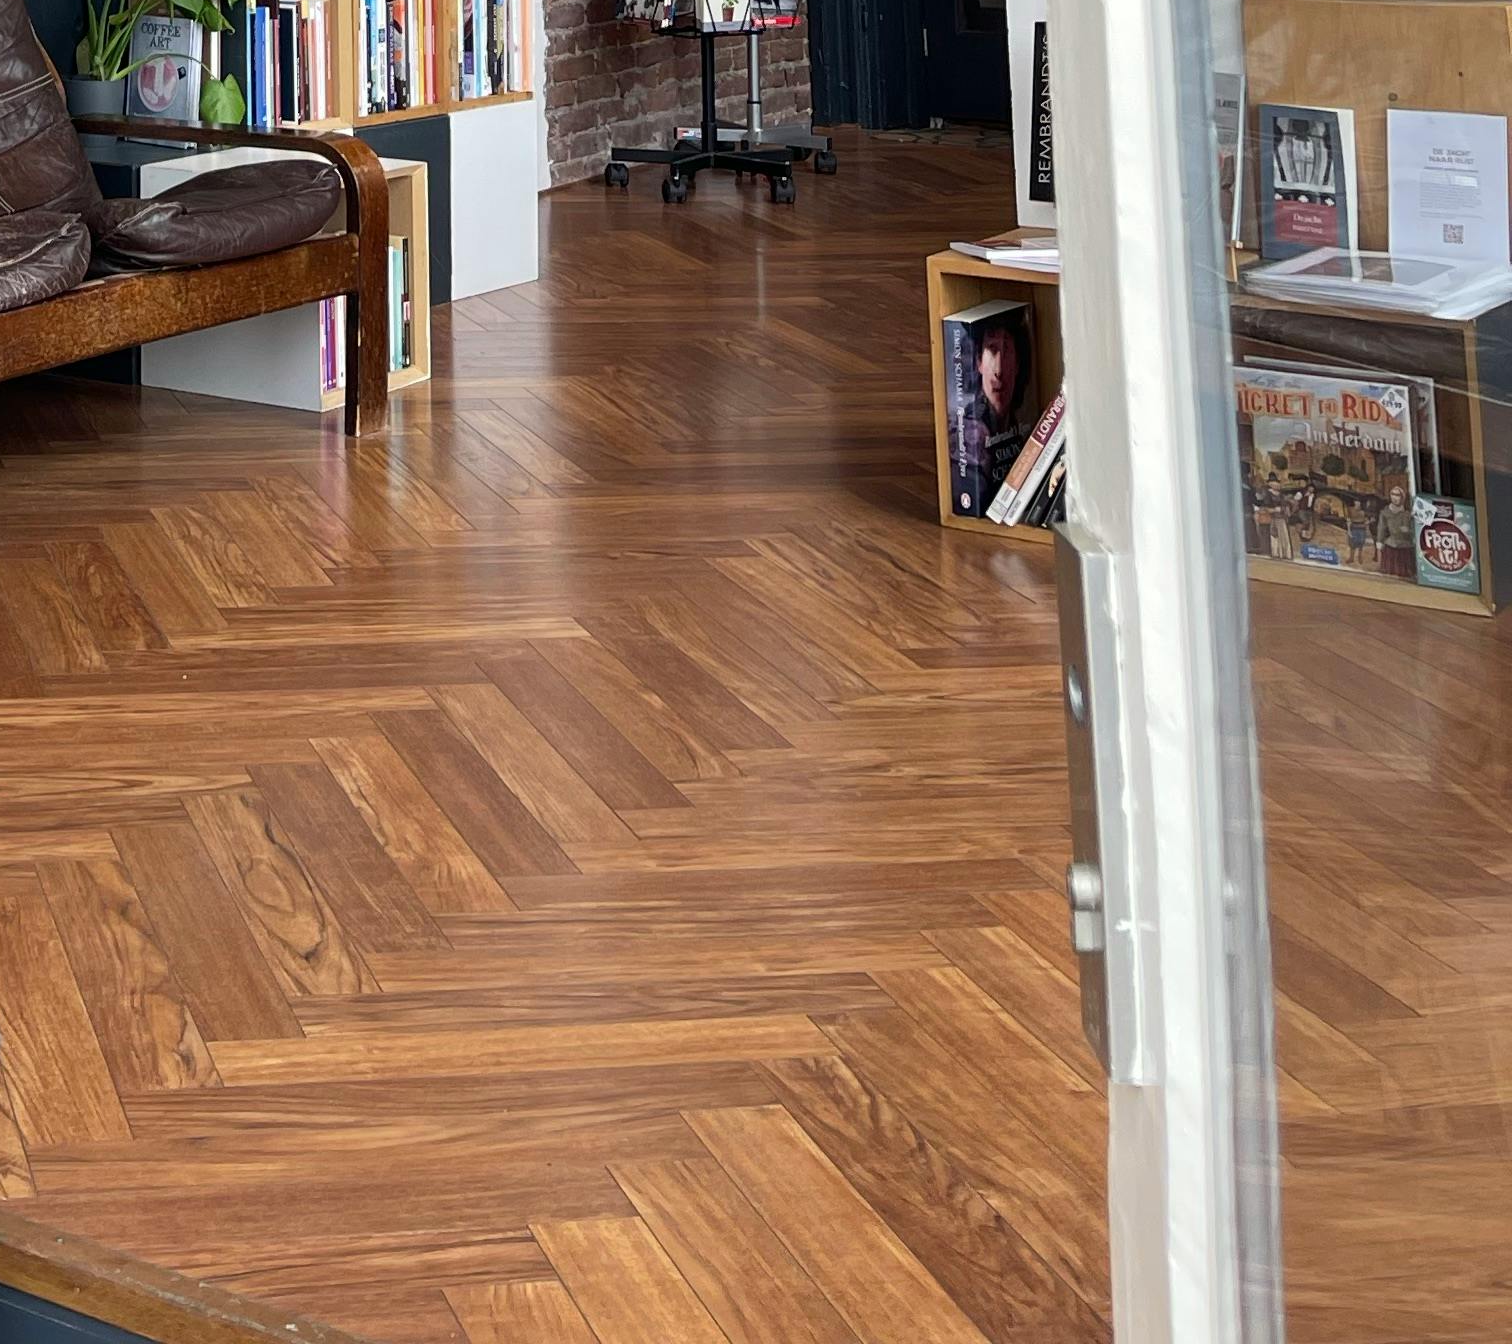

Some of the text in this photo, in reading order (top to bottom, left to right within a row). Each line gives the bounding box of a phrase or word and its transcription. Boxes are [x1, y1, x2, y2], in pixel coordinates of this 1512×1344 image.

[140, 21, 182, 38] COFFEE
[149, 36, 173, 50] ART
[953, 328, 962, 360] SIMON
[954, 361, 964, 402] SCHAMA
[956, 405, 966, 458] Rembrandt's
[1289, 422, 1402, 453] Amsterdam
